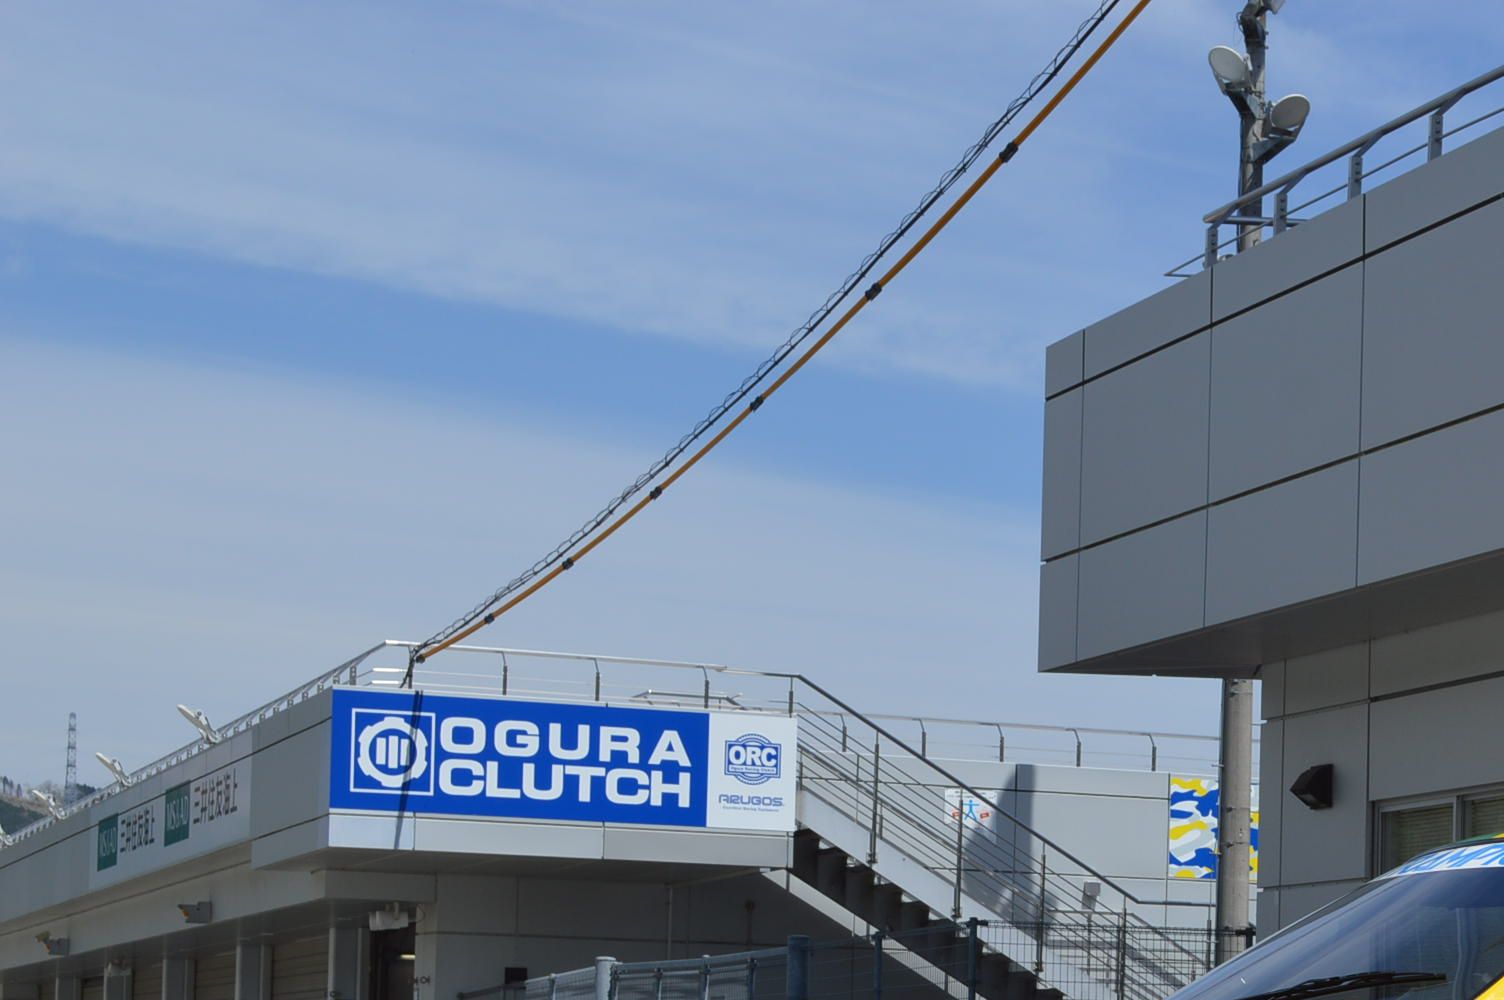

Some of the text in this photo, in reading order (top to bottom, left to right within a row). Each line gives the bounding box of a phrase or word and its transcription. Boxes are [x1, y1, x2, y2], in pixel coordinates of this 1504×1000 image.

[440, 716, 692, 767] OGURA
[728, 745, 777, 767] ORC
[438, 759, 691, 808] CLUTCH
